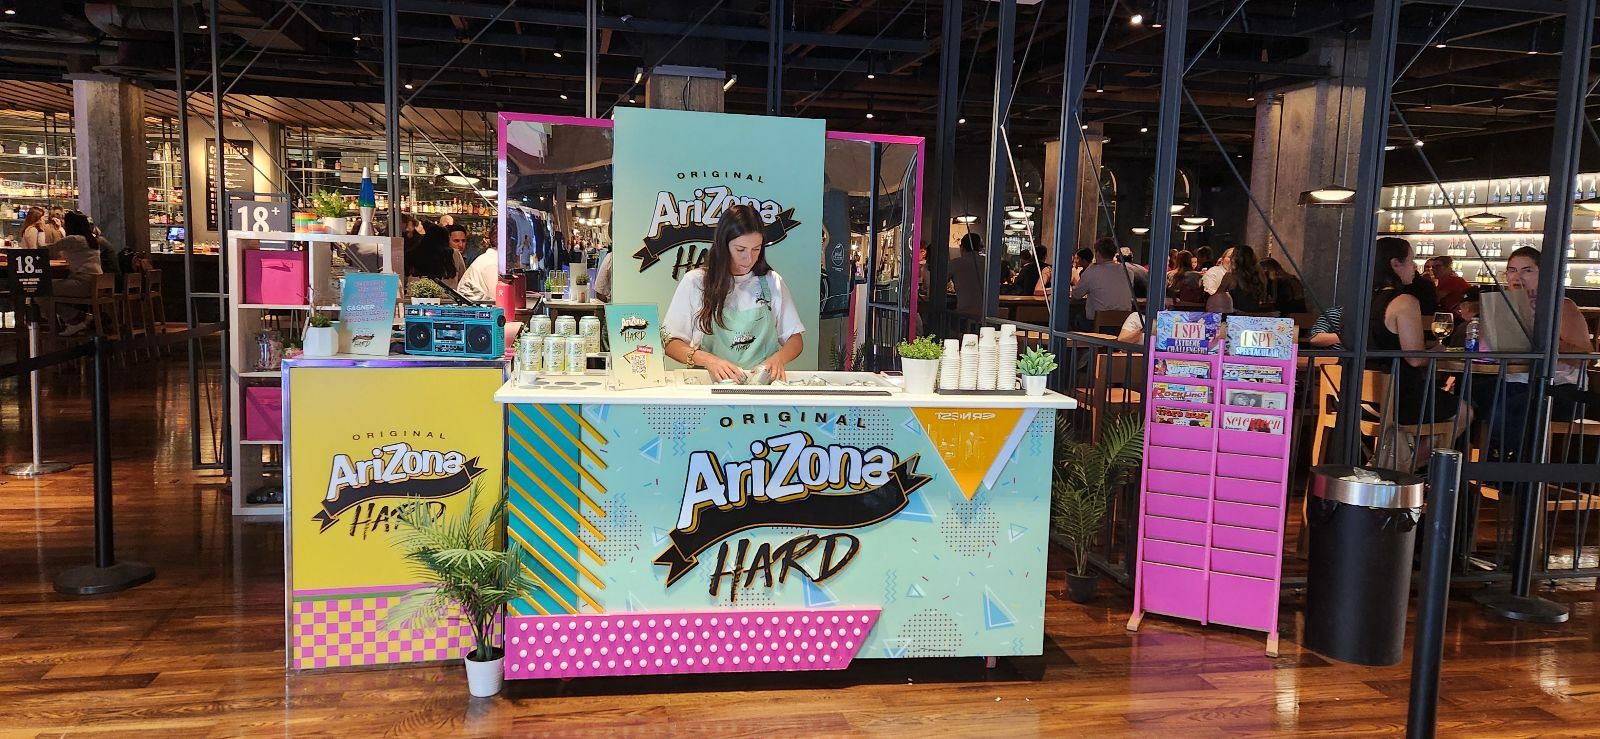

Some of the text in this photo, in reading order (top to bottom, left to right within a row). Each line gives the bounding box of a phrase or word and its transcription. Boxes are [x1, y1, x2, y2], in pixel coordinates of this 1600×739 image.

[677, 171, 764, 184] ORIGINAL
[672, 245, 709, 281] HA
[1183, 324, 1203, 339] SPY
[1251, 332, 1273, 347] SPY
[1235, 347, 1280, 358] SPECTACULAR
[719, 411, 867, 429] ORIGINAL
[1226, 416, 1281, 430] seveen
[352, 430, 446, 441] ORIGINAL
[326, 442, 466, 502] AriZona
[675, 430, 900, 534] AriZona
[708, 532, 861, 602] HARD
